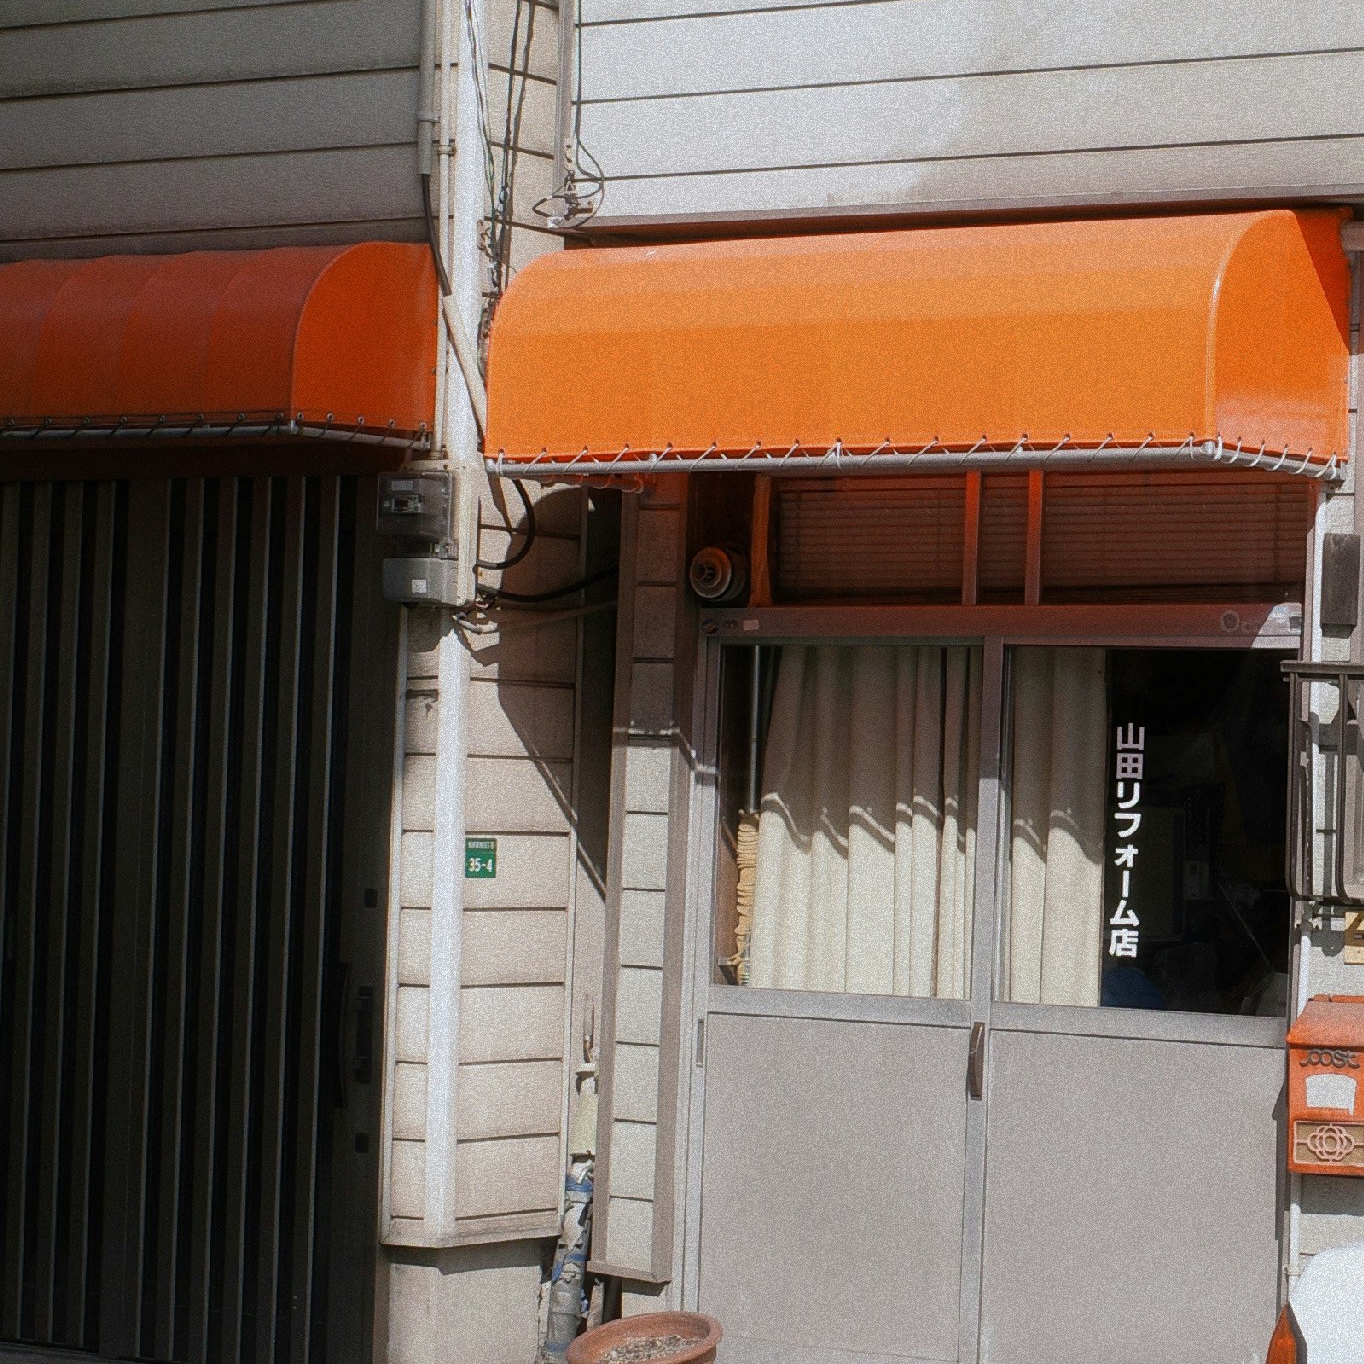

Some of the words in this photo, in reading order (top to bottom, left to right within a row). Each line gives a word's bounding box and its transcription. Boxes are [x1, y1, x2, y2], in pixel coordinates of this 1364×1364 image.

[467, 857, 493, 873] 35-4
[1108, 722, 1146, 958] 山田リフォーム店
